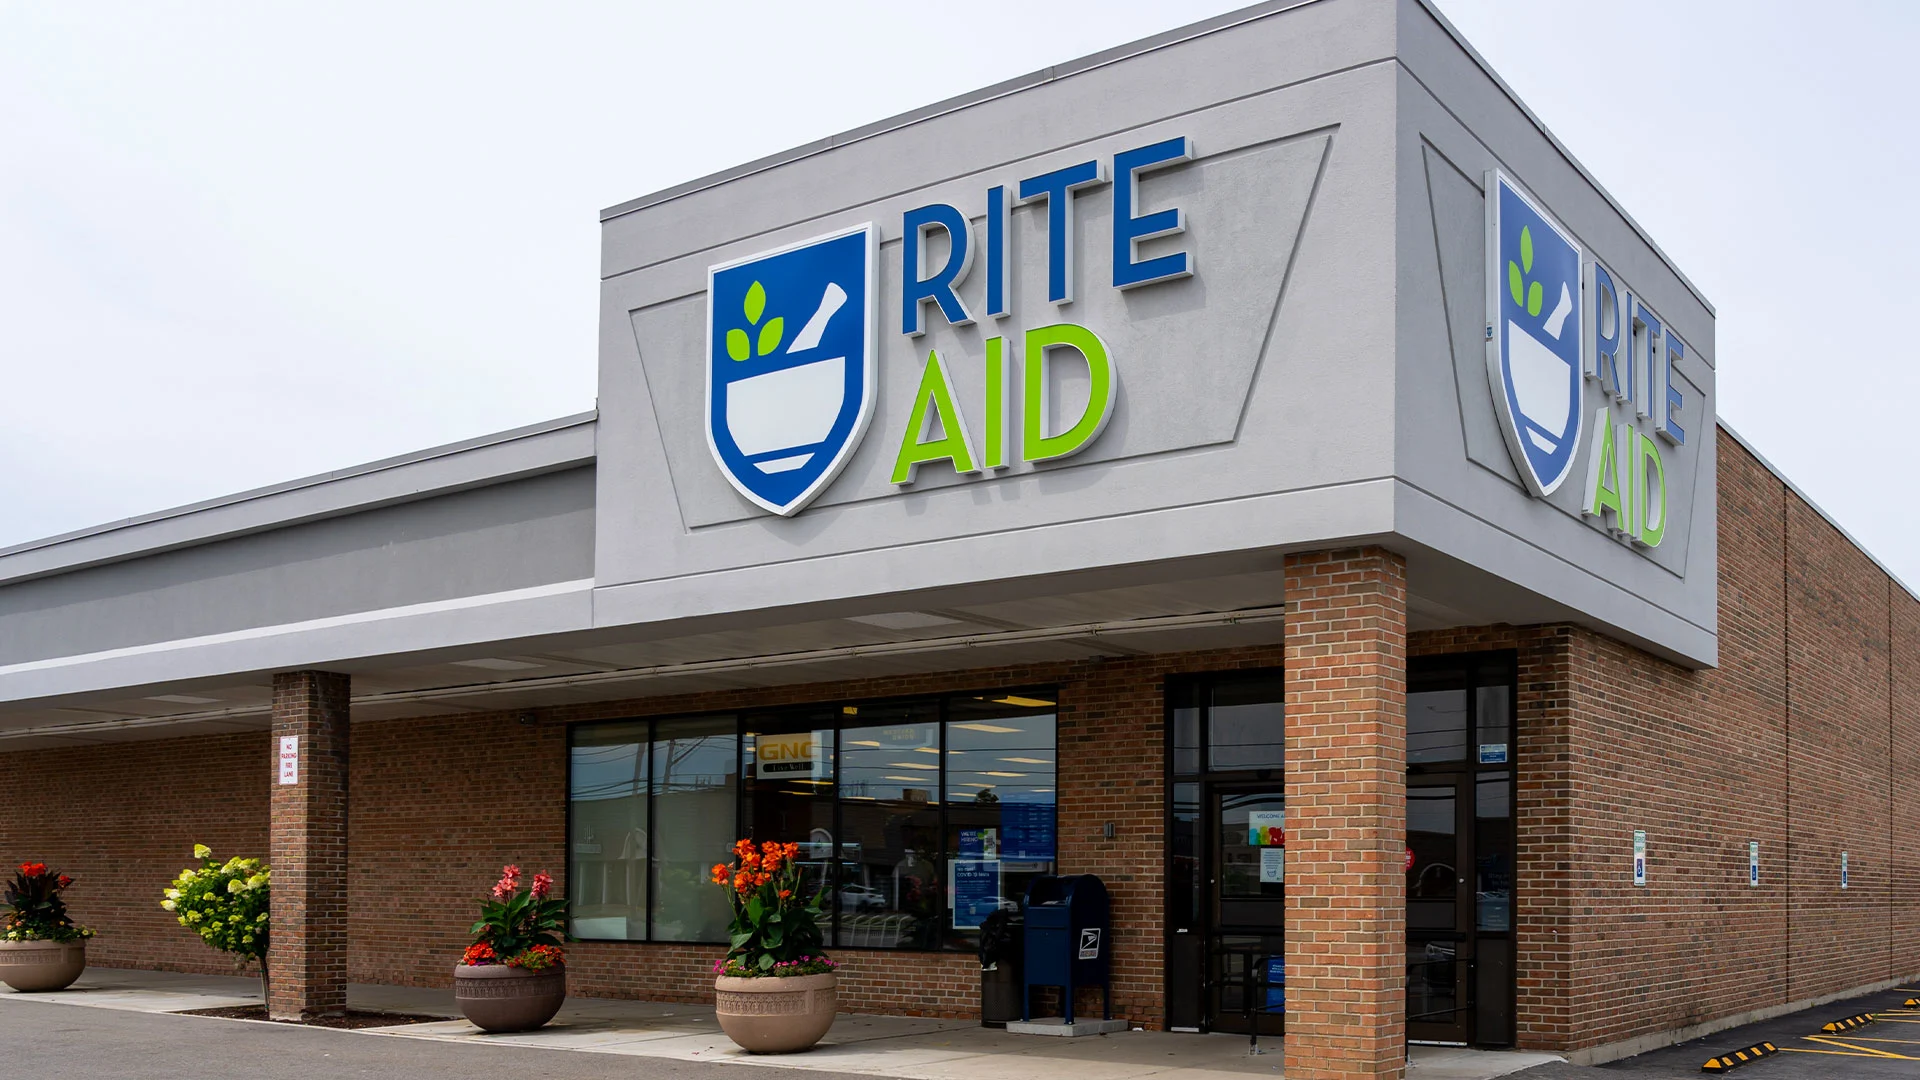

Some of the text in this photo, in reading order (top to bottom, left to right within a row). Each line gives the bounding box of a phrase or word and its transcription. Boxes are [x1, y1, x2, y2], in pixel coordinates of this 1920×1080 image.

[901, 136, 1194, 337] RITE
[890, 323, 1118, 485] AID
[1586, 260, 1686, 446] RITE
[1584, 407, 1667, 548] AID
[758, 741, 818, 761] GNC
